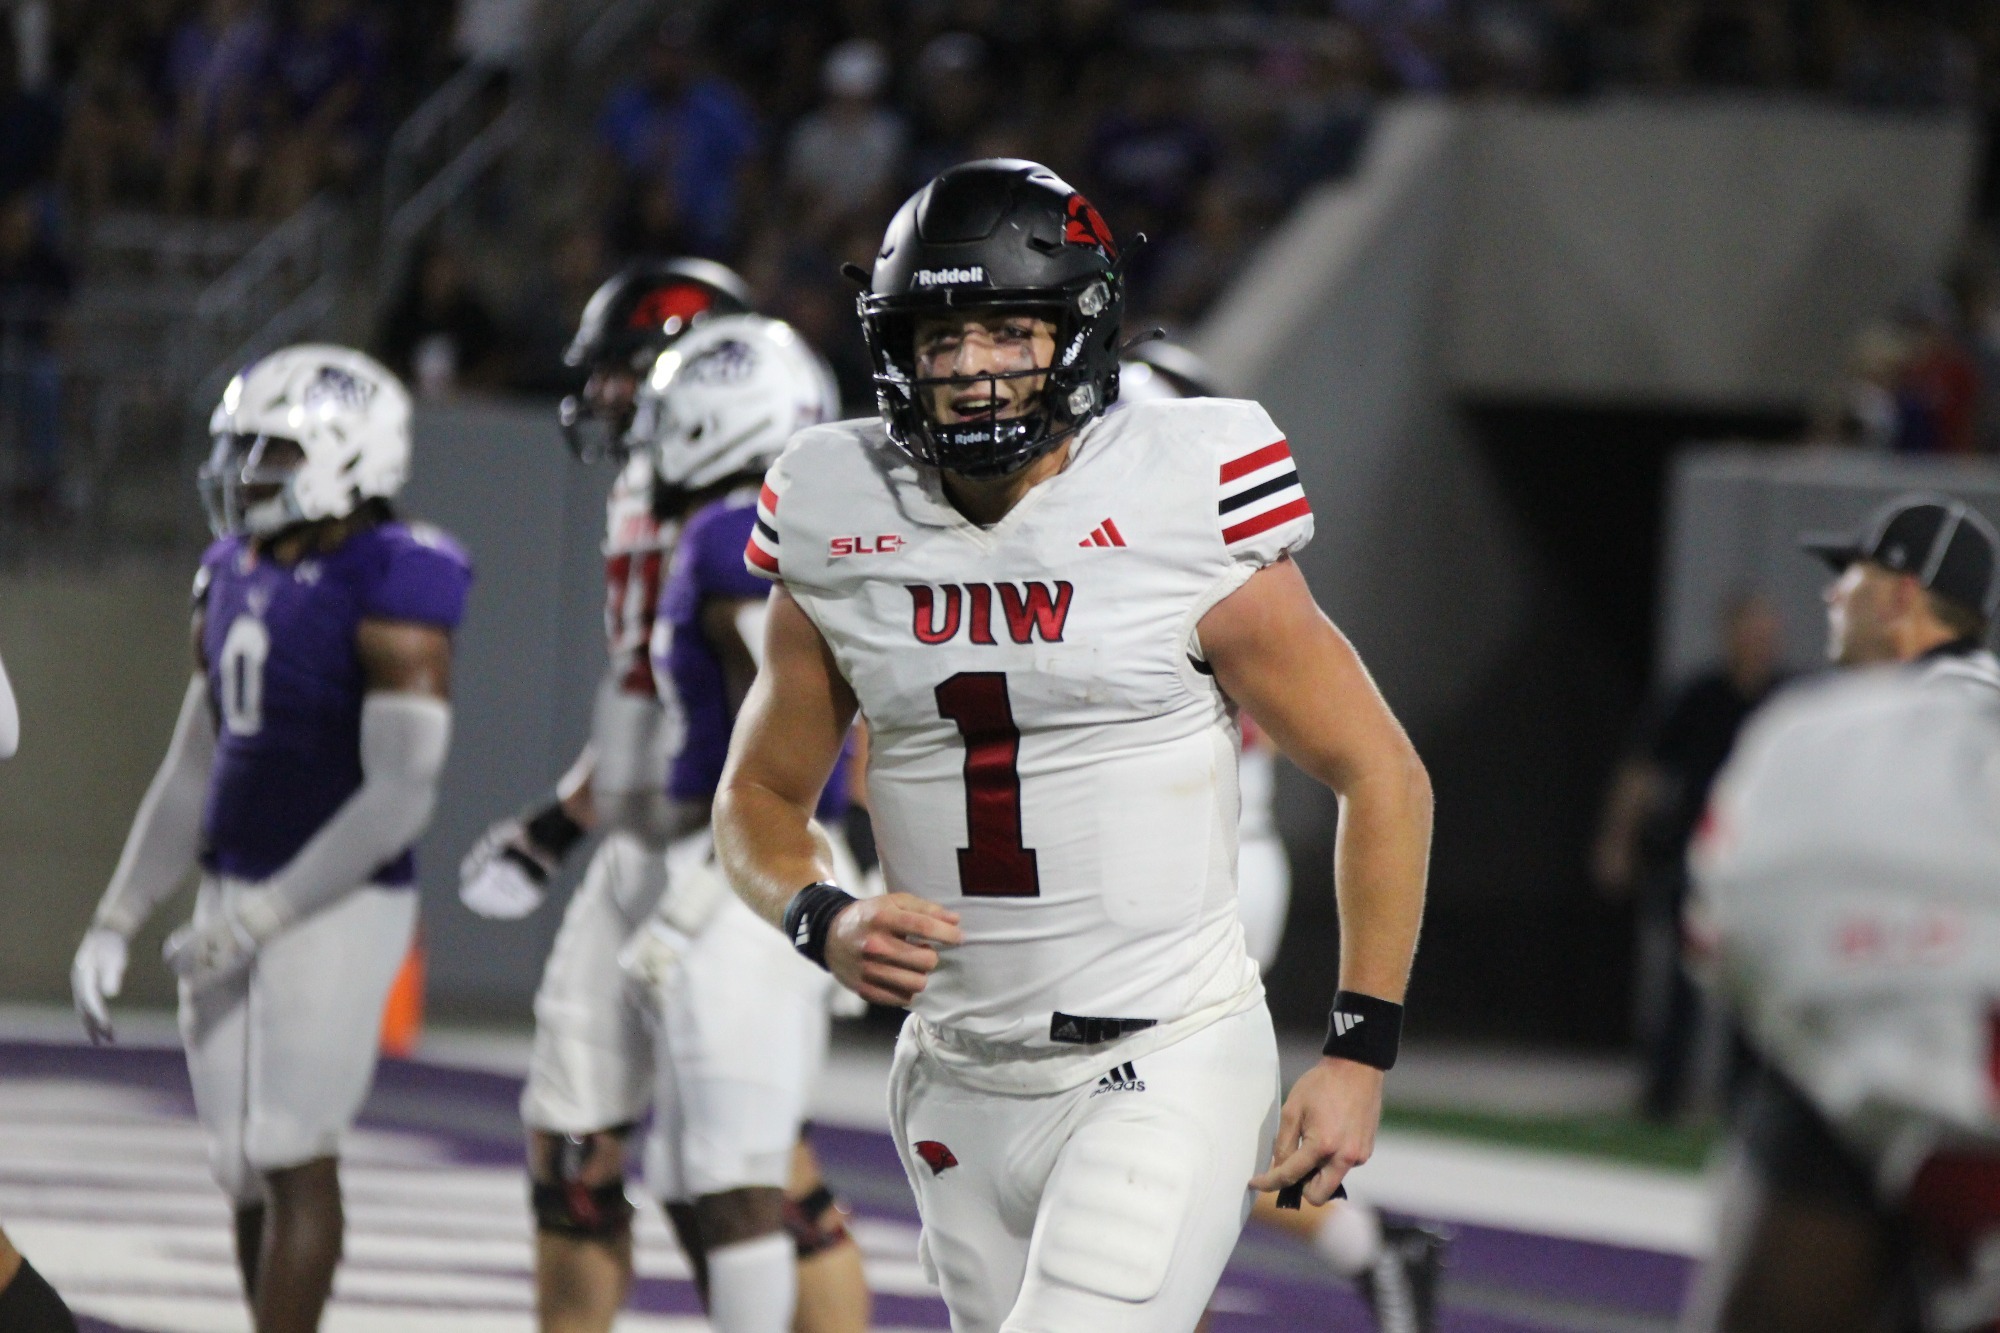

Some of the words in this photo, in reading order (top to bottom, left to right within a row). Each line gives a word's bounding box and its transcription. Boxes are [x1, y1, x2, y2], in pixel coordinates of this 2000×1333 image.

[918, 265, 984, 286] Riddell
[830, 533, 899, 557] SLC
[904, 580, 1074, 646] UIW
[219, 614, 271, 737] 0
[934, 671, 1040, 897] 1
[1089, 1079, 1146, 1099] adidas
